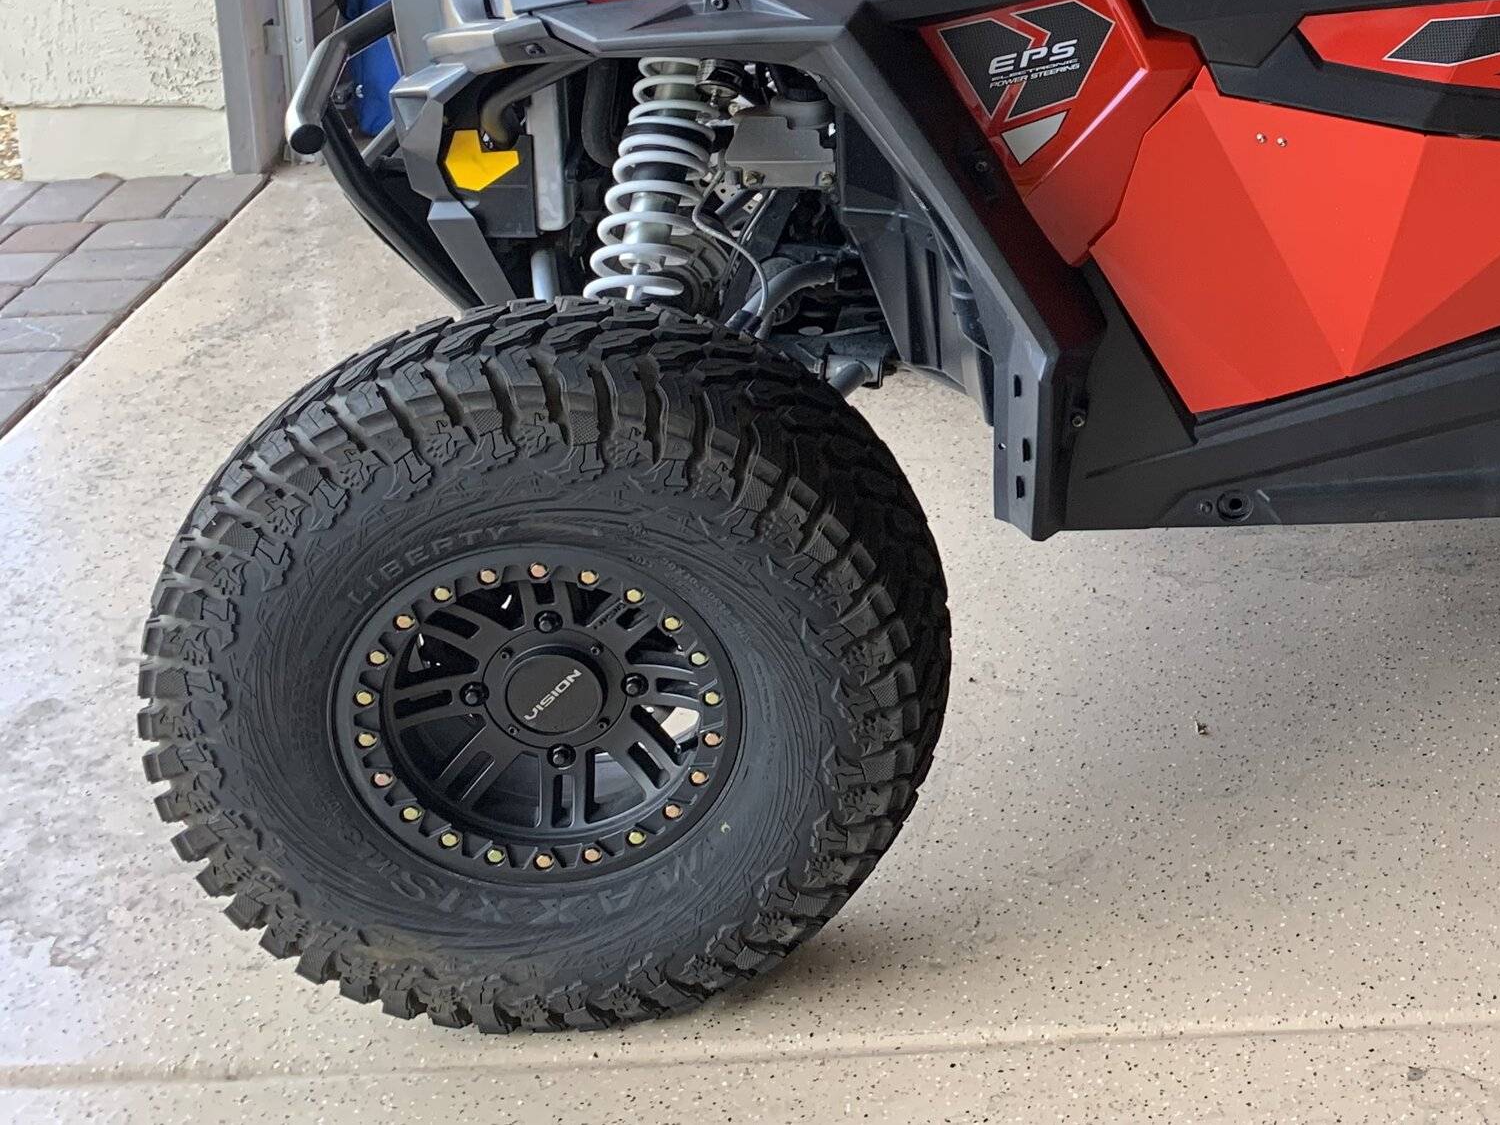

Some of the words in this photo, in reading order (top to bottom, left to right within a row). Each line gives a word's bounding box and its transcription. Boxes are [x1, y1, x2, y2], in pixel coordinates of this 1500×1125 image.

[988, 39, 1078, 75] EPS
[991, 58, 1079, 82] ELECTRONIC
[989, 75, 1029, 89] POWER
[1030, 63, 1080, 81] STEERING
[346, 524, 513, 605] LIBERTY
[524, 669, 582, 720] VISION
